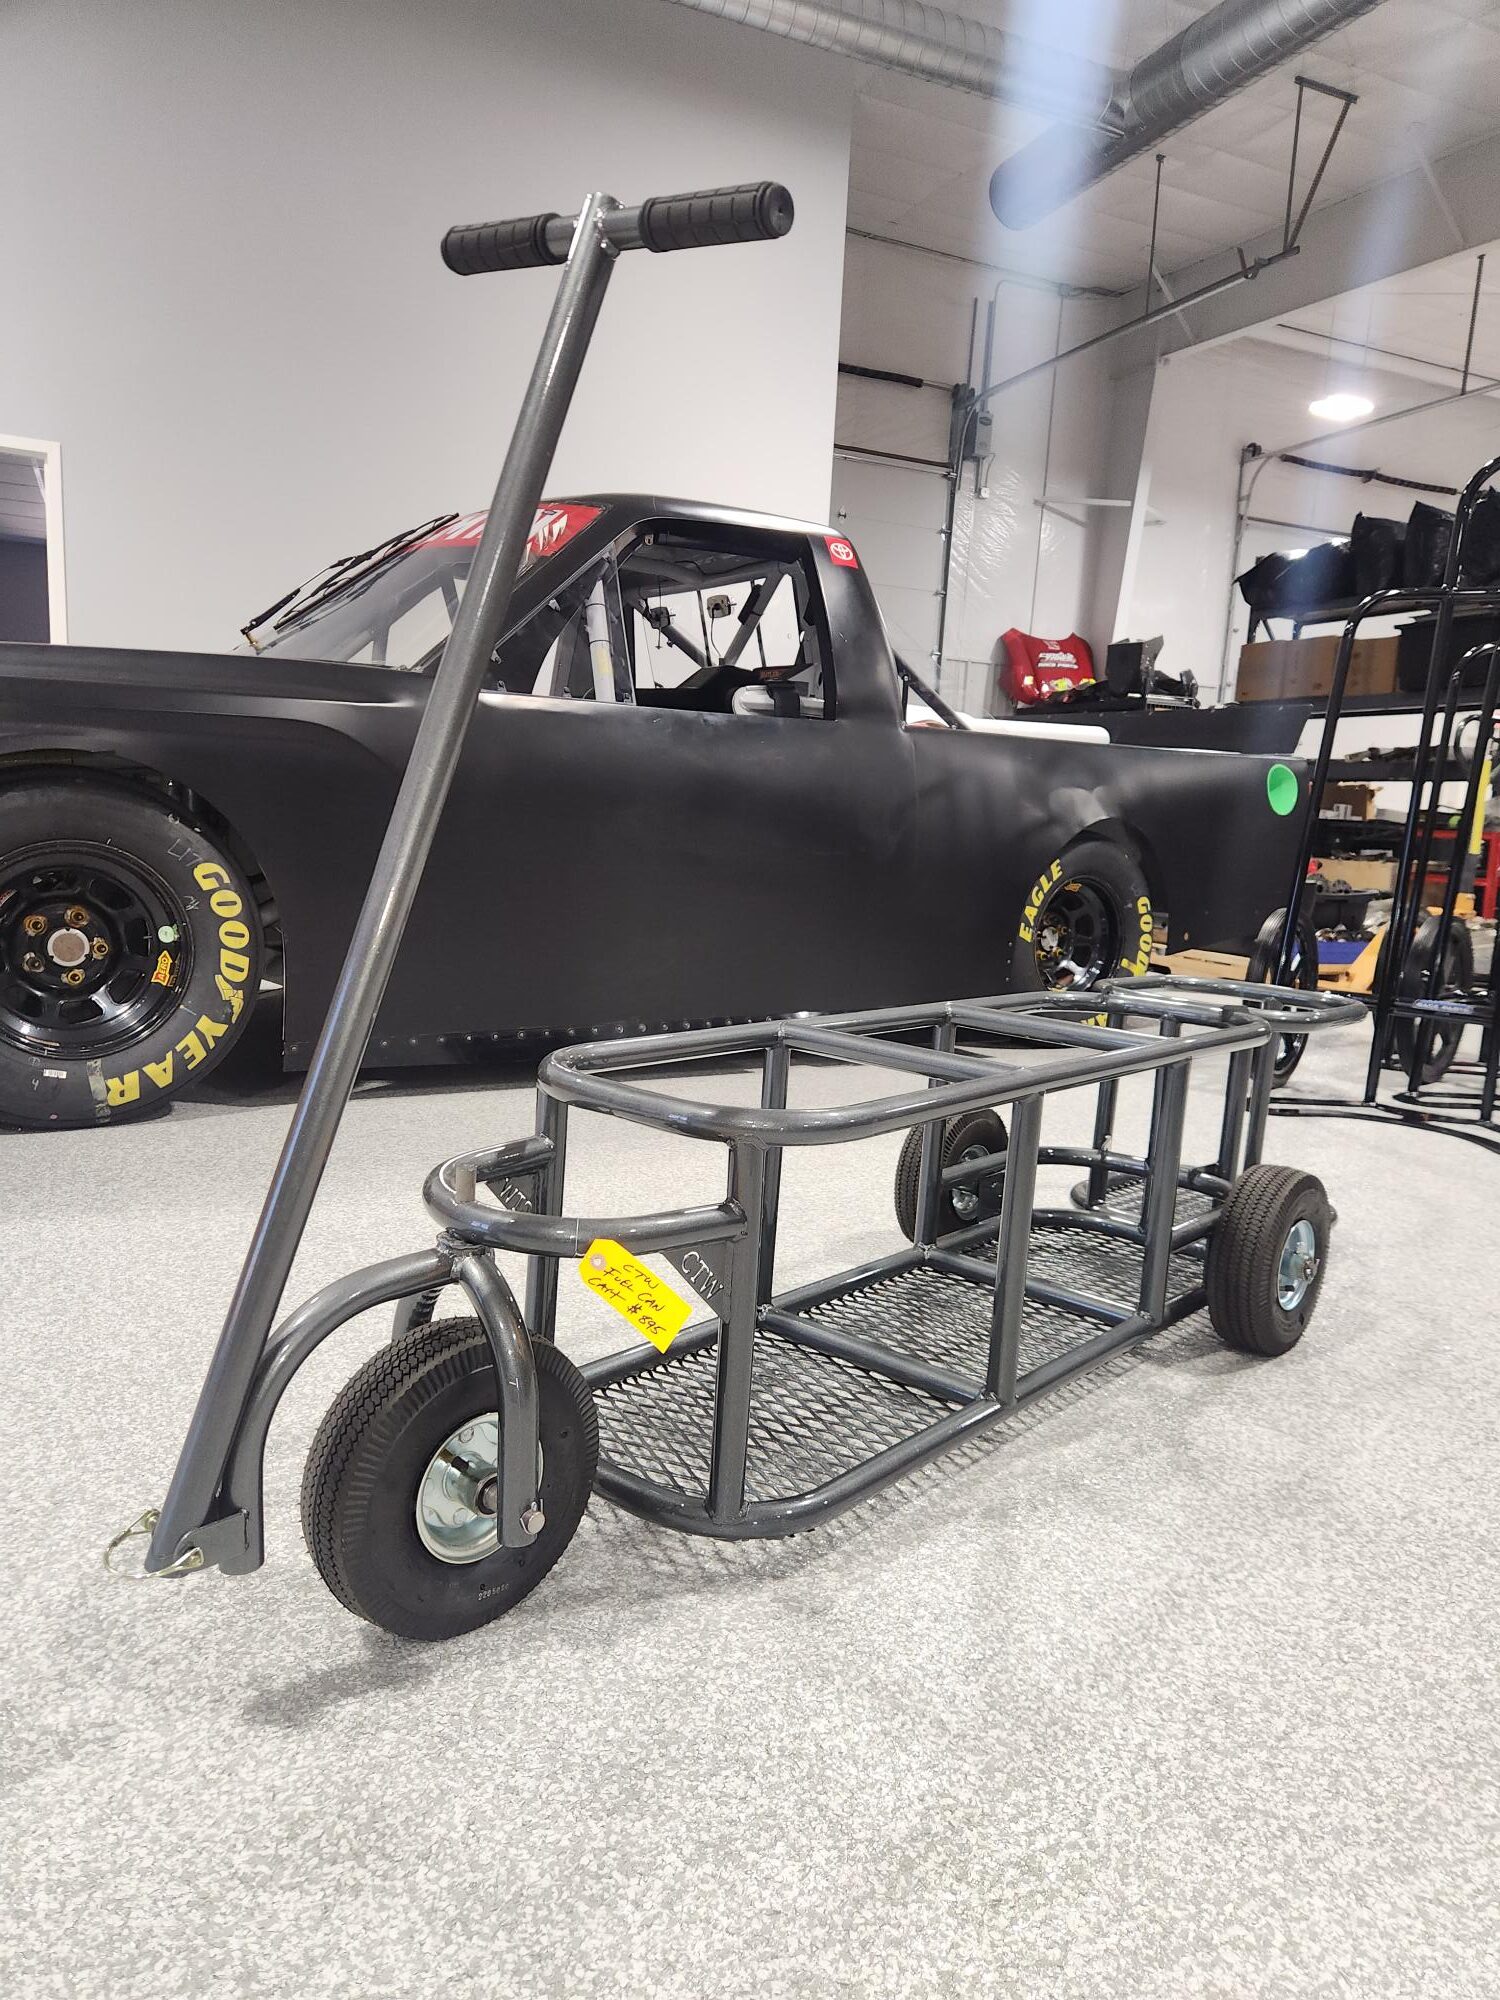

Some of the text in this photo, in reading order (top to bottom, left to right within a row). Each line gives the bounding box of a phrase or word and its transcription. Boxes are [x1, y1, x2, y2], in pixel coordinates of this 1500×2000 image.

[1019, 858, 1064, 943] EAGLE
[106, 862, 250, 1107] GOODYEAR
[603, 1266, 665, 1312] FUEL CAN
[681, 1251, 724, 1300] CTW
